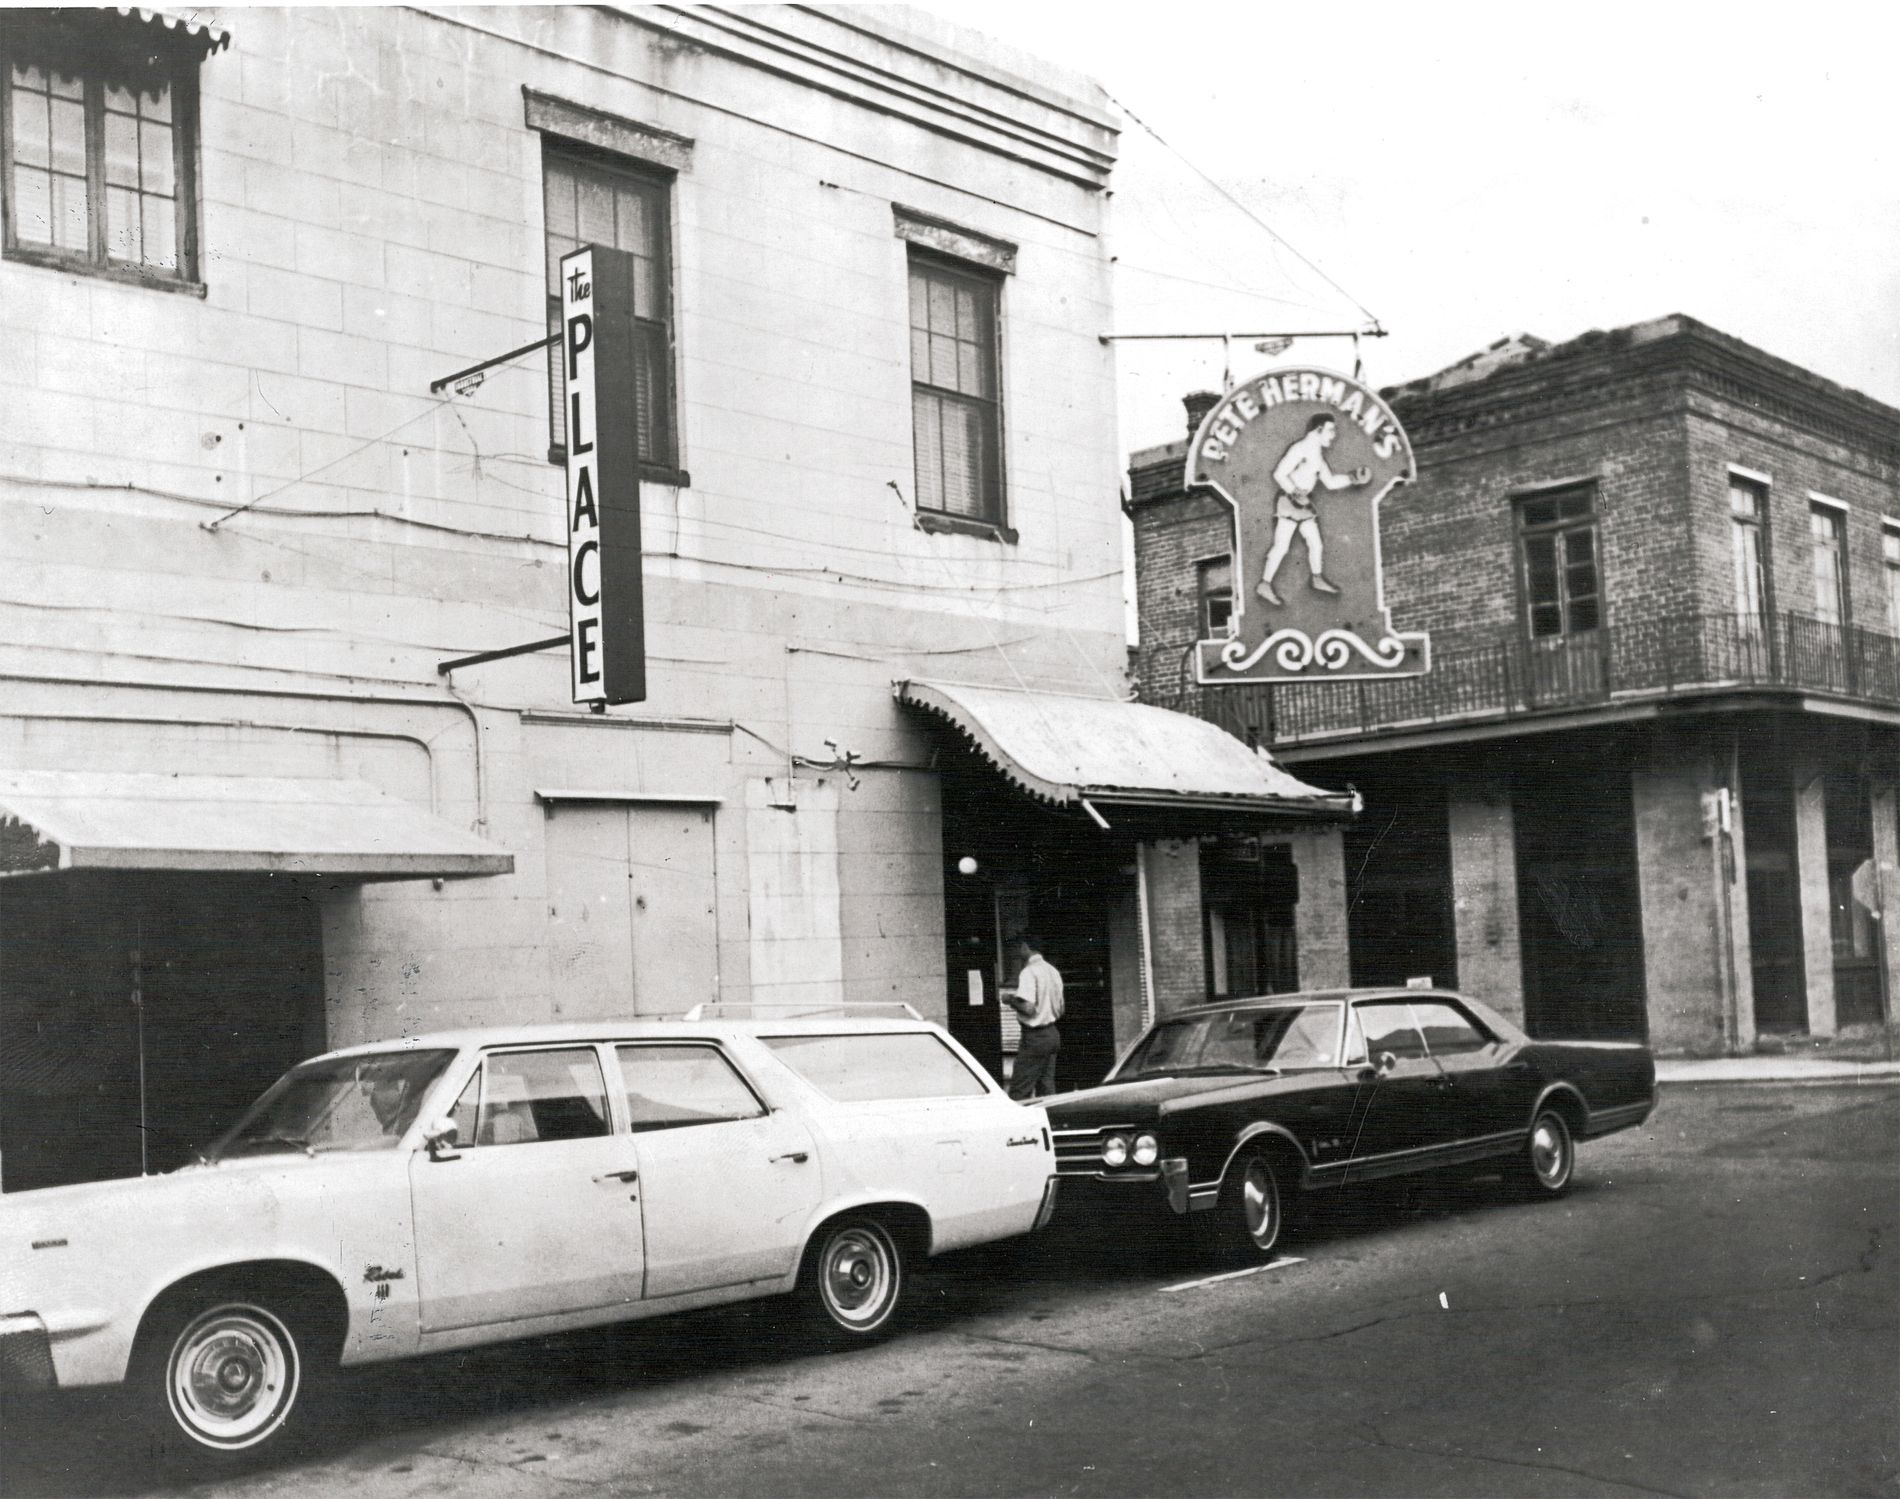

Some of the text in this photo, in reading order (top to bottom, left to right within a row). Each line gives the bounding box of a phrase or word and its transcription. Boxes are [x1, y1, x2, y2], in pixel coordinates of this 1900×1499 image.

[568, 314, 600, 685] PLACE
[1202, 373, 1402, 462] PETE HERMAN'S
